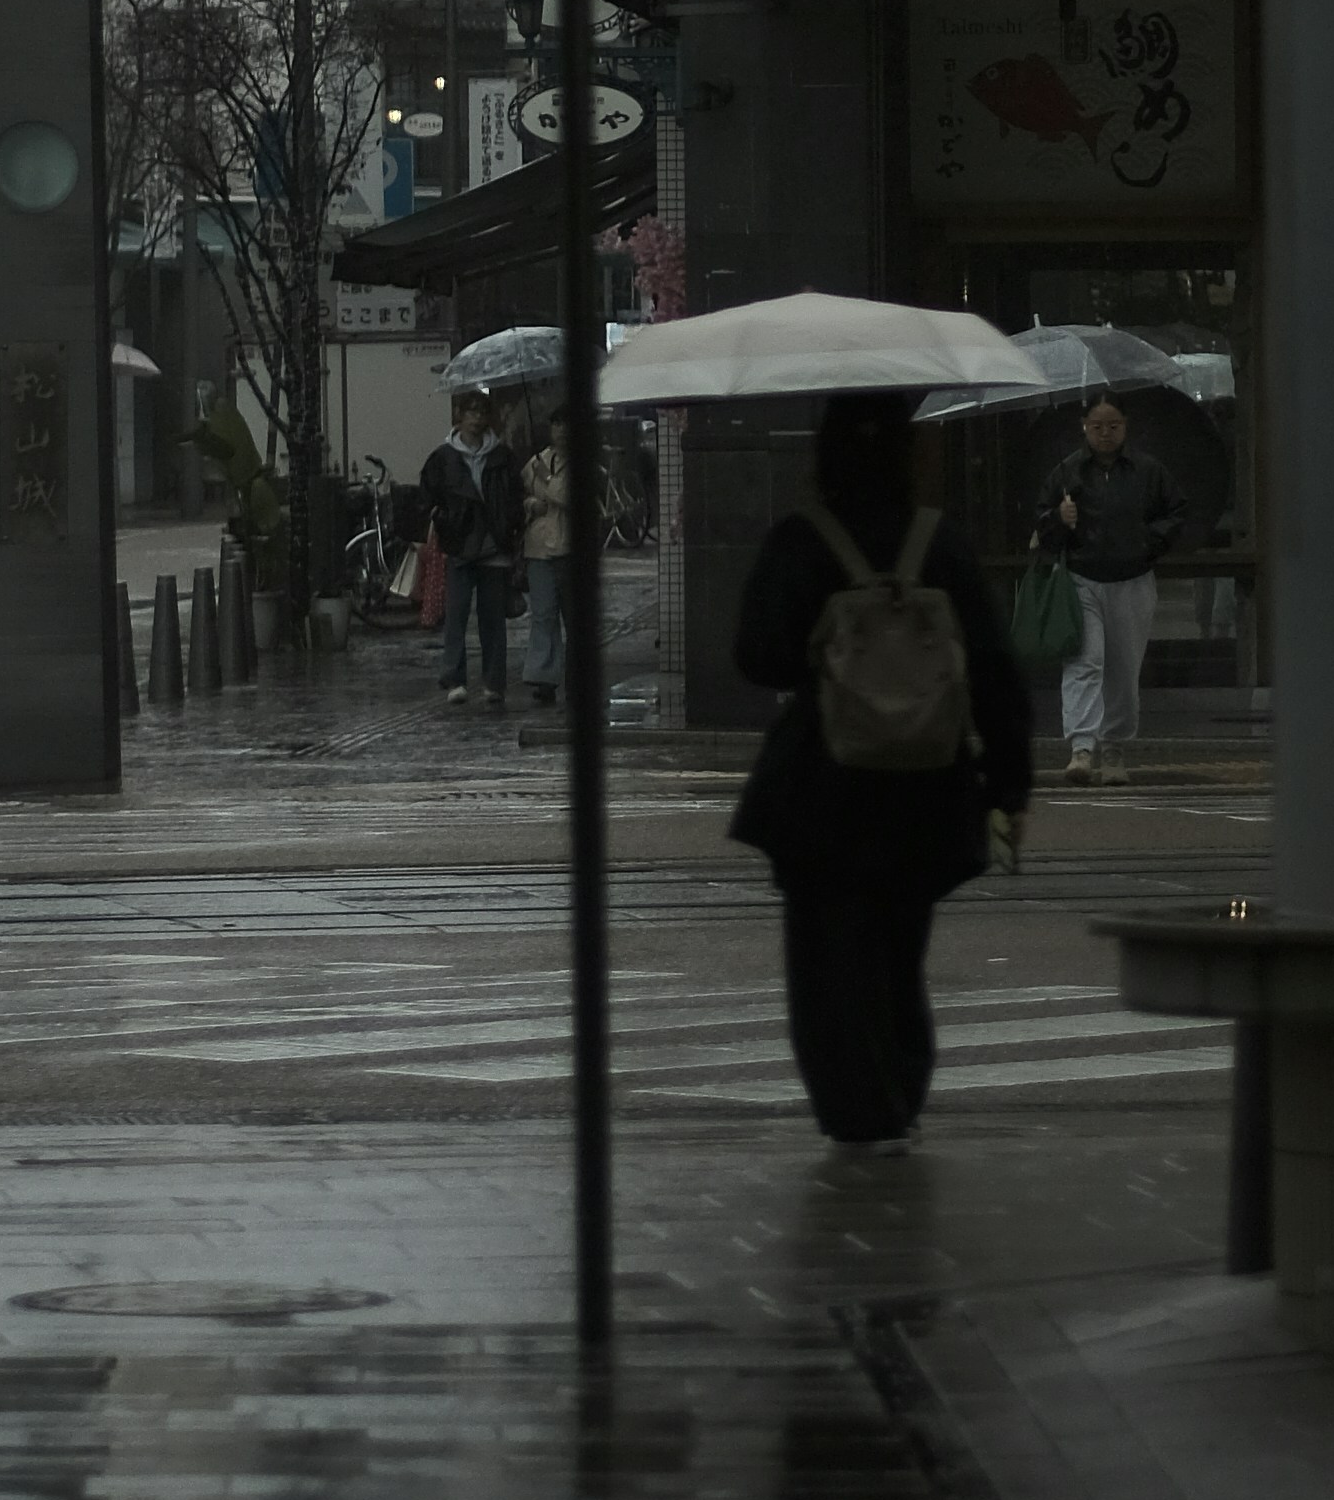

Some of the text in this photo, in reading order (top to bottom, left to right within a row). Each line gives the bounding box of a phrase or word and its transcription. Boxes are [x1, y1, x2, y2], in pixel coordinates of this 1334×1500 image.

[340, 306, 411, 325] ここまで
[8, 364, 58, 519] 松山城
